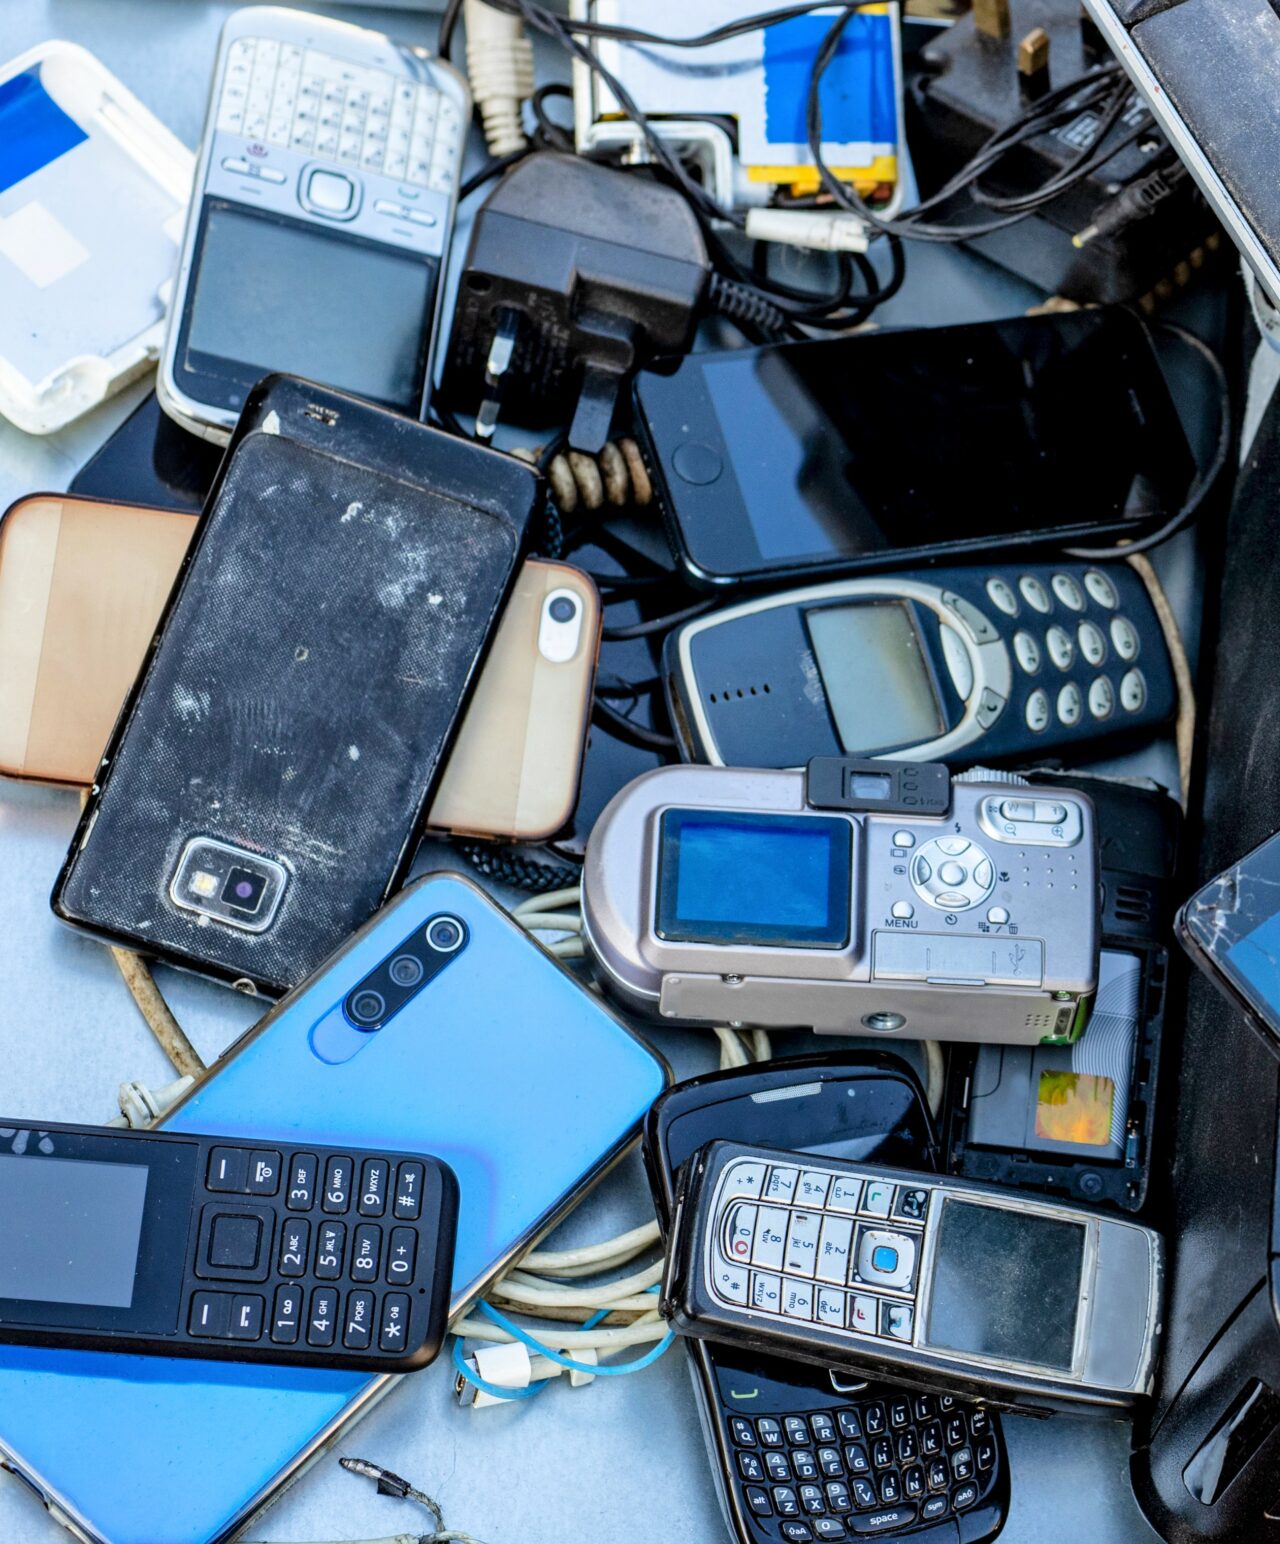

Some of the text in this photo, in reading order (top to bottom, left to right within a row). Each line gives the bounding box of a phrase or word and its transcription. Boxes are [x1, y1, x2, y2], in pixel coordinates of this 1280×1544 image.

[885, 919, 918, 929] MENU
[292, 1169, 308, 1200] 3 DEF
[328, 1169, 344, 1202] 6 MNO
[364, 1169, 380, 1204] 9 WXYZ
[781, 1181, 791, 1189] 7
[813, 1185, 824, 1193] 4
[740, 1228, 751, 1236] 0
[770, 1234, 781, 1243] 8
[284, 1235, 300, 1264] 2 ABC
[320, 1239, 336, 1266] 5 JKL
[356, 1240, 373, 1268] 8 TUV
[835, 1247, 846, 1255] 2
[392, 1261, 408, 1271] 0
[766, 1292, 777, 1300] 9
[797, 1298, 808, 1306] 6
[829, 1306, 840, 1314] 3
[313, 1301, 330, 1331] 4 GHI
[350, 1301, 366, 1333] 7 PQRS
[790, 1420, 798, 1428] 2
[816, 1418, 824, 1426] 3
[870, 1420, 878, 1429] Y
[822, 1429, 831, 1438] R
[847, 1425, 855, 1434] T
[741, 1432, 752, 1441] Q
[766, 1433, 777, 1442] W
[952, 1431, 959, 1439] L
[927, 1440, 935, 1449] K
[772, 1456, 781, 1464] 4
[798, 1454, 806, 1462] 5
[824, 1451, 832, 1460] 6
[878, 1453, 887, 1463] H
[855, 1458, 864, 1467] G
[748, 1467, 756, 1475] A
[777, 1468, 786, 1476] S
[803, 1466, 812, 1475] D
[830, 1463, 838, 1472] F
[934, 1473, 943, 1483] M
[831, 1485, 840, 1494] 9
[910, 1481, 919, 1490] N
[779, 1490, 788, 1498] 7
[805, 1488, 814, 1497] 8
[862, 1492, 871, 1501] V
[885, 1488, 893, 1496] B
[754, 1496, 765, 1504] alt
[811, 1500, 820, 1509] X
[838, 1497, 846, 1505] C
[785, 1503, 794, 1511] Z
[928, 1502, 942, 1511] sym
[870, 1513, 898, 1525] space
